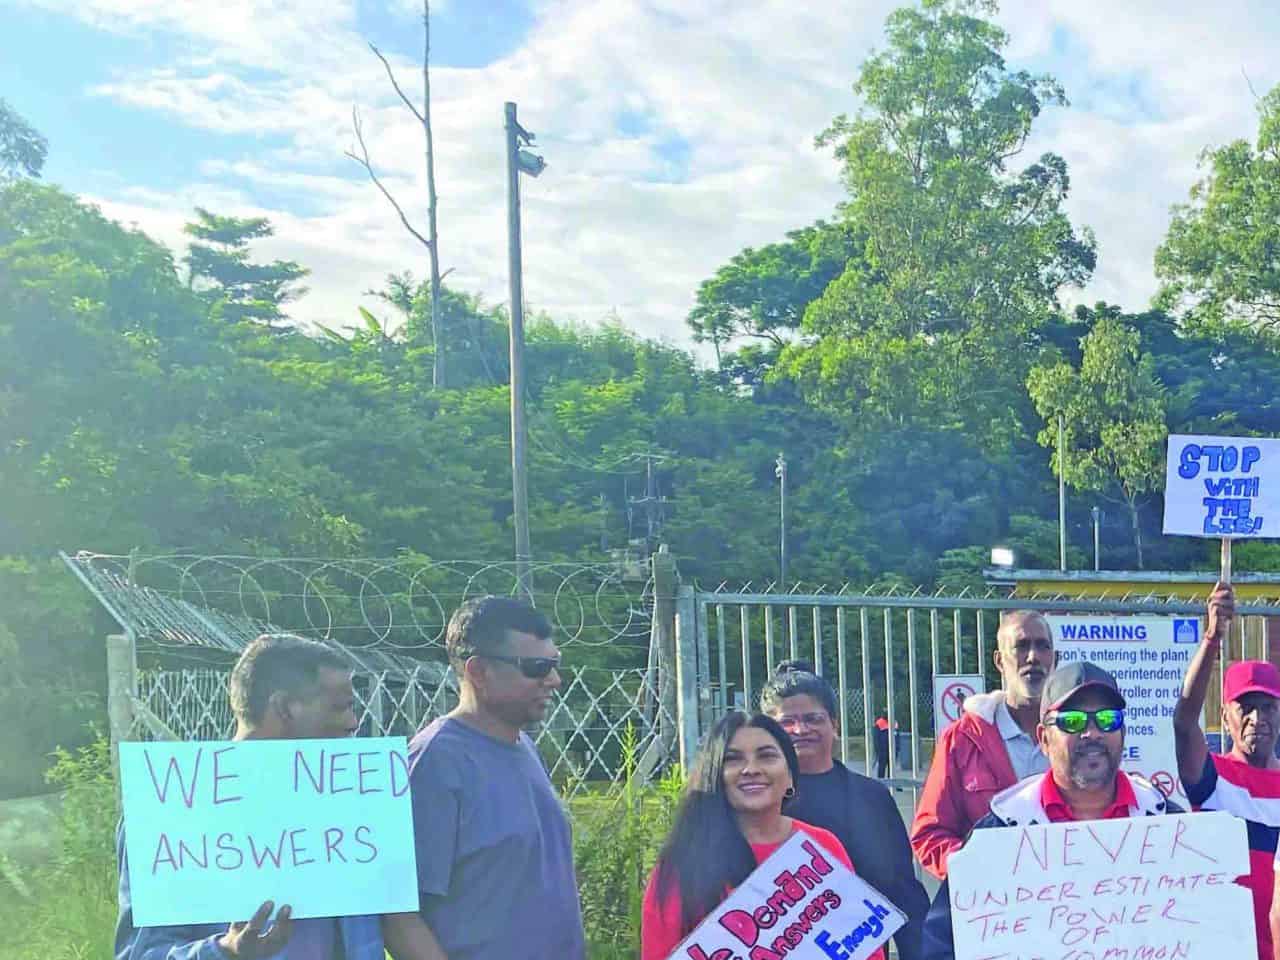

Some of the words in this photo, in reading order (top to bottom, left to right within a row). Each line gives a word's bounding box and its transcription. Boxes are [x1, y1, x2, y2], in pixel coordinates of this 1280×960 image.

[1178, 443, 1261, 479] STOP
[1203, 498, 1252, 519] THE
[1061, 624, 1147, 640] WARNING
[1090, 649, 1136, 664] entering
[1140, 649, 1159, 661] the
[1161, 649, 1188, 665] plant
[1155, 688, 1169, 698] on
[143, 747, 243, 809] WE
[293, 749, 411, 798] NEED
[152, 825, 378, 876] ANSWERS
[1013, 819, 1217, 876] NEVER
[954, 881, 1081, 911] UNDER
[968, 911, 1032, 942] THE
[1048, 898, 1200, 930] POWER
[1062, 926, 1110, 946] OF
